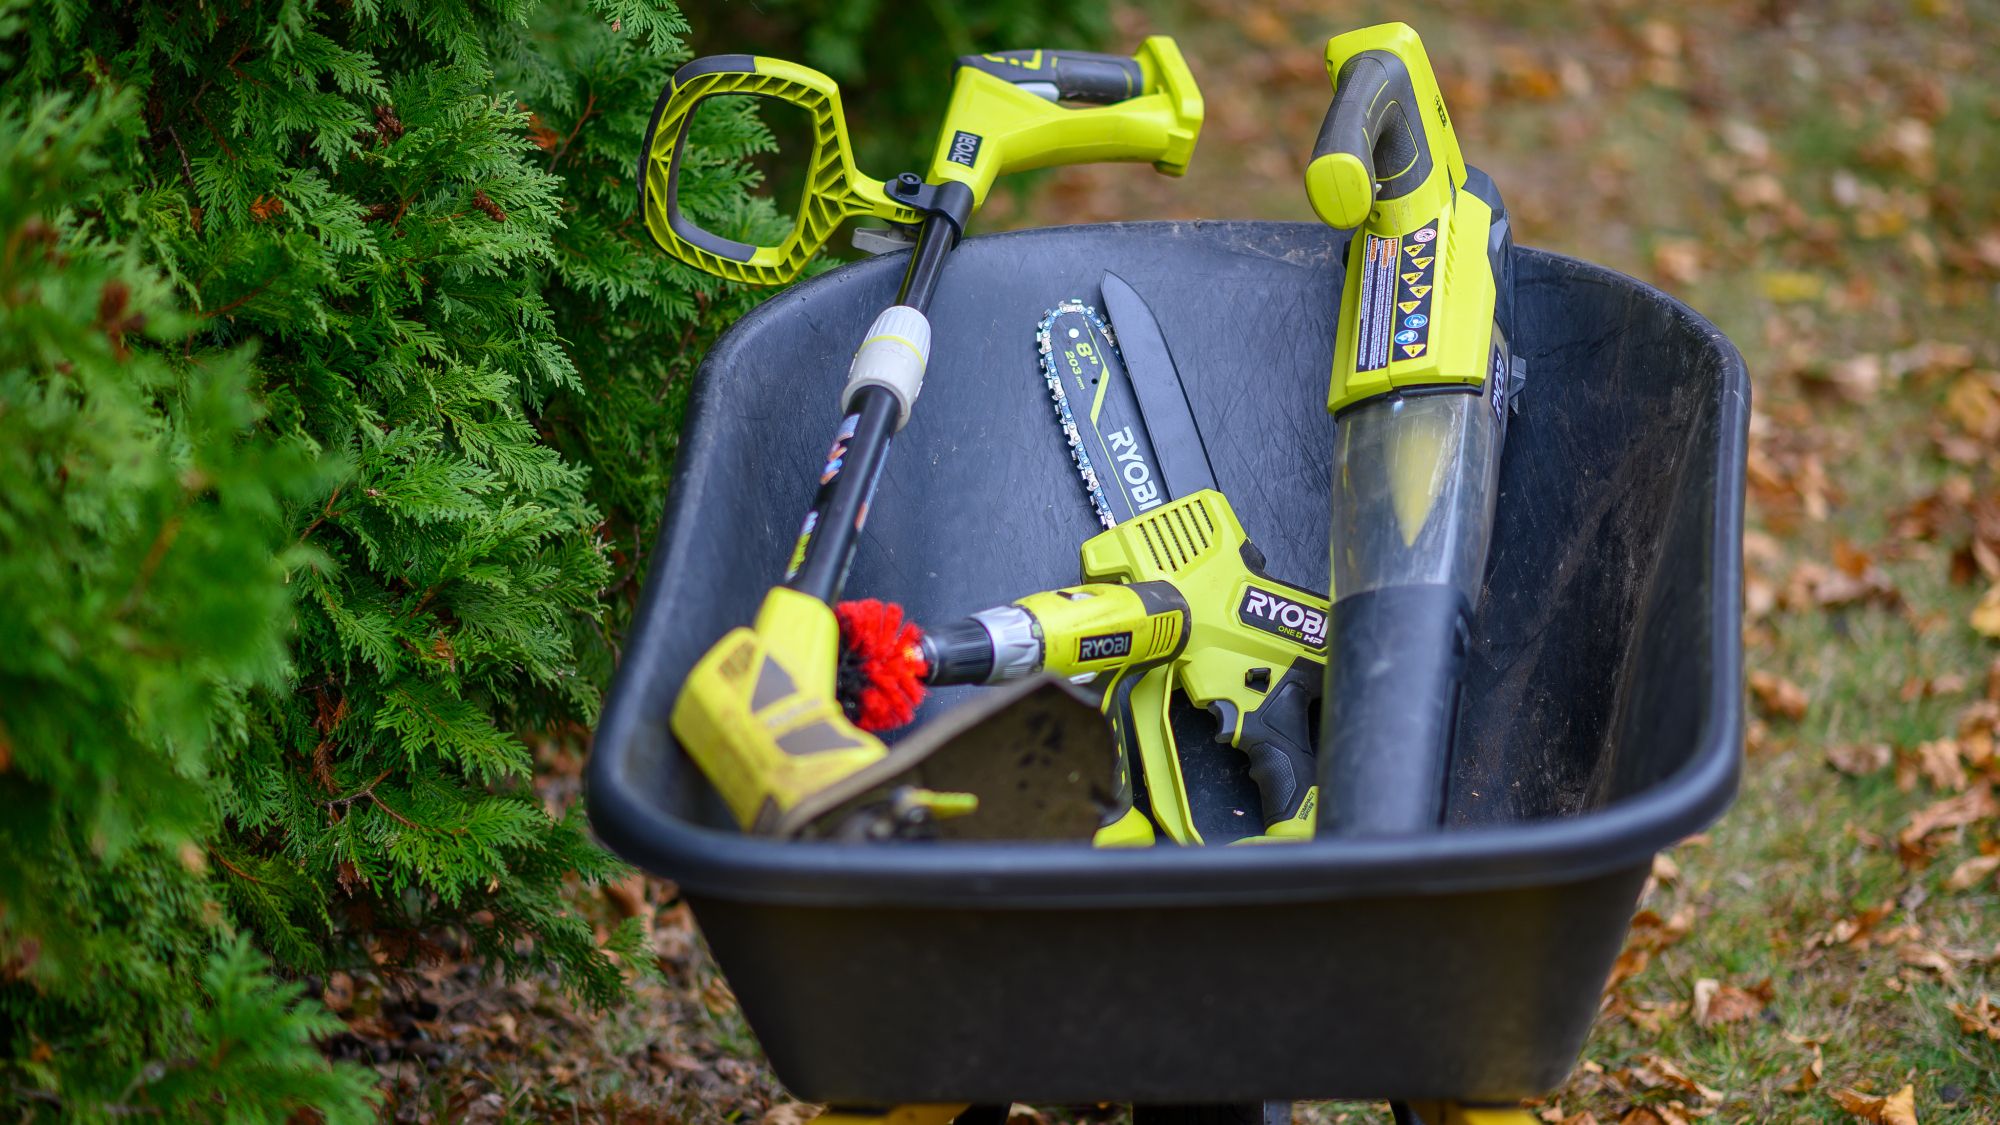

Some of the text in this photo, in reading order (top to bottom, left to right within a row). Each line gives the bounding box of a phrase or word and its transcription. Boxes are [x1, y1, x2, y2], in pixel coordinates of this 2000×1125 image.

[952, 132, 978, 165] RYOBI
[1076, 342, 1098, 365] 8"
[1064, 350, 1085, 390] 203 mm
[1107, 426, 1162, 511] RYOBI
[1246, 591, 1328, 638] RYOBI
[1081, 636, 1130, 659] RYOBI
[1303, 634, 1324, 645] HP
[1298, 790, 1315, 820] COMPACT
